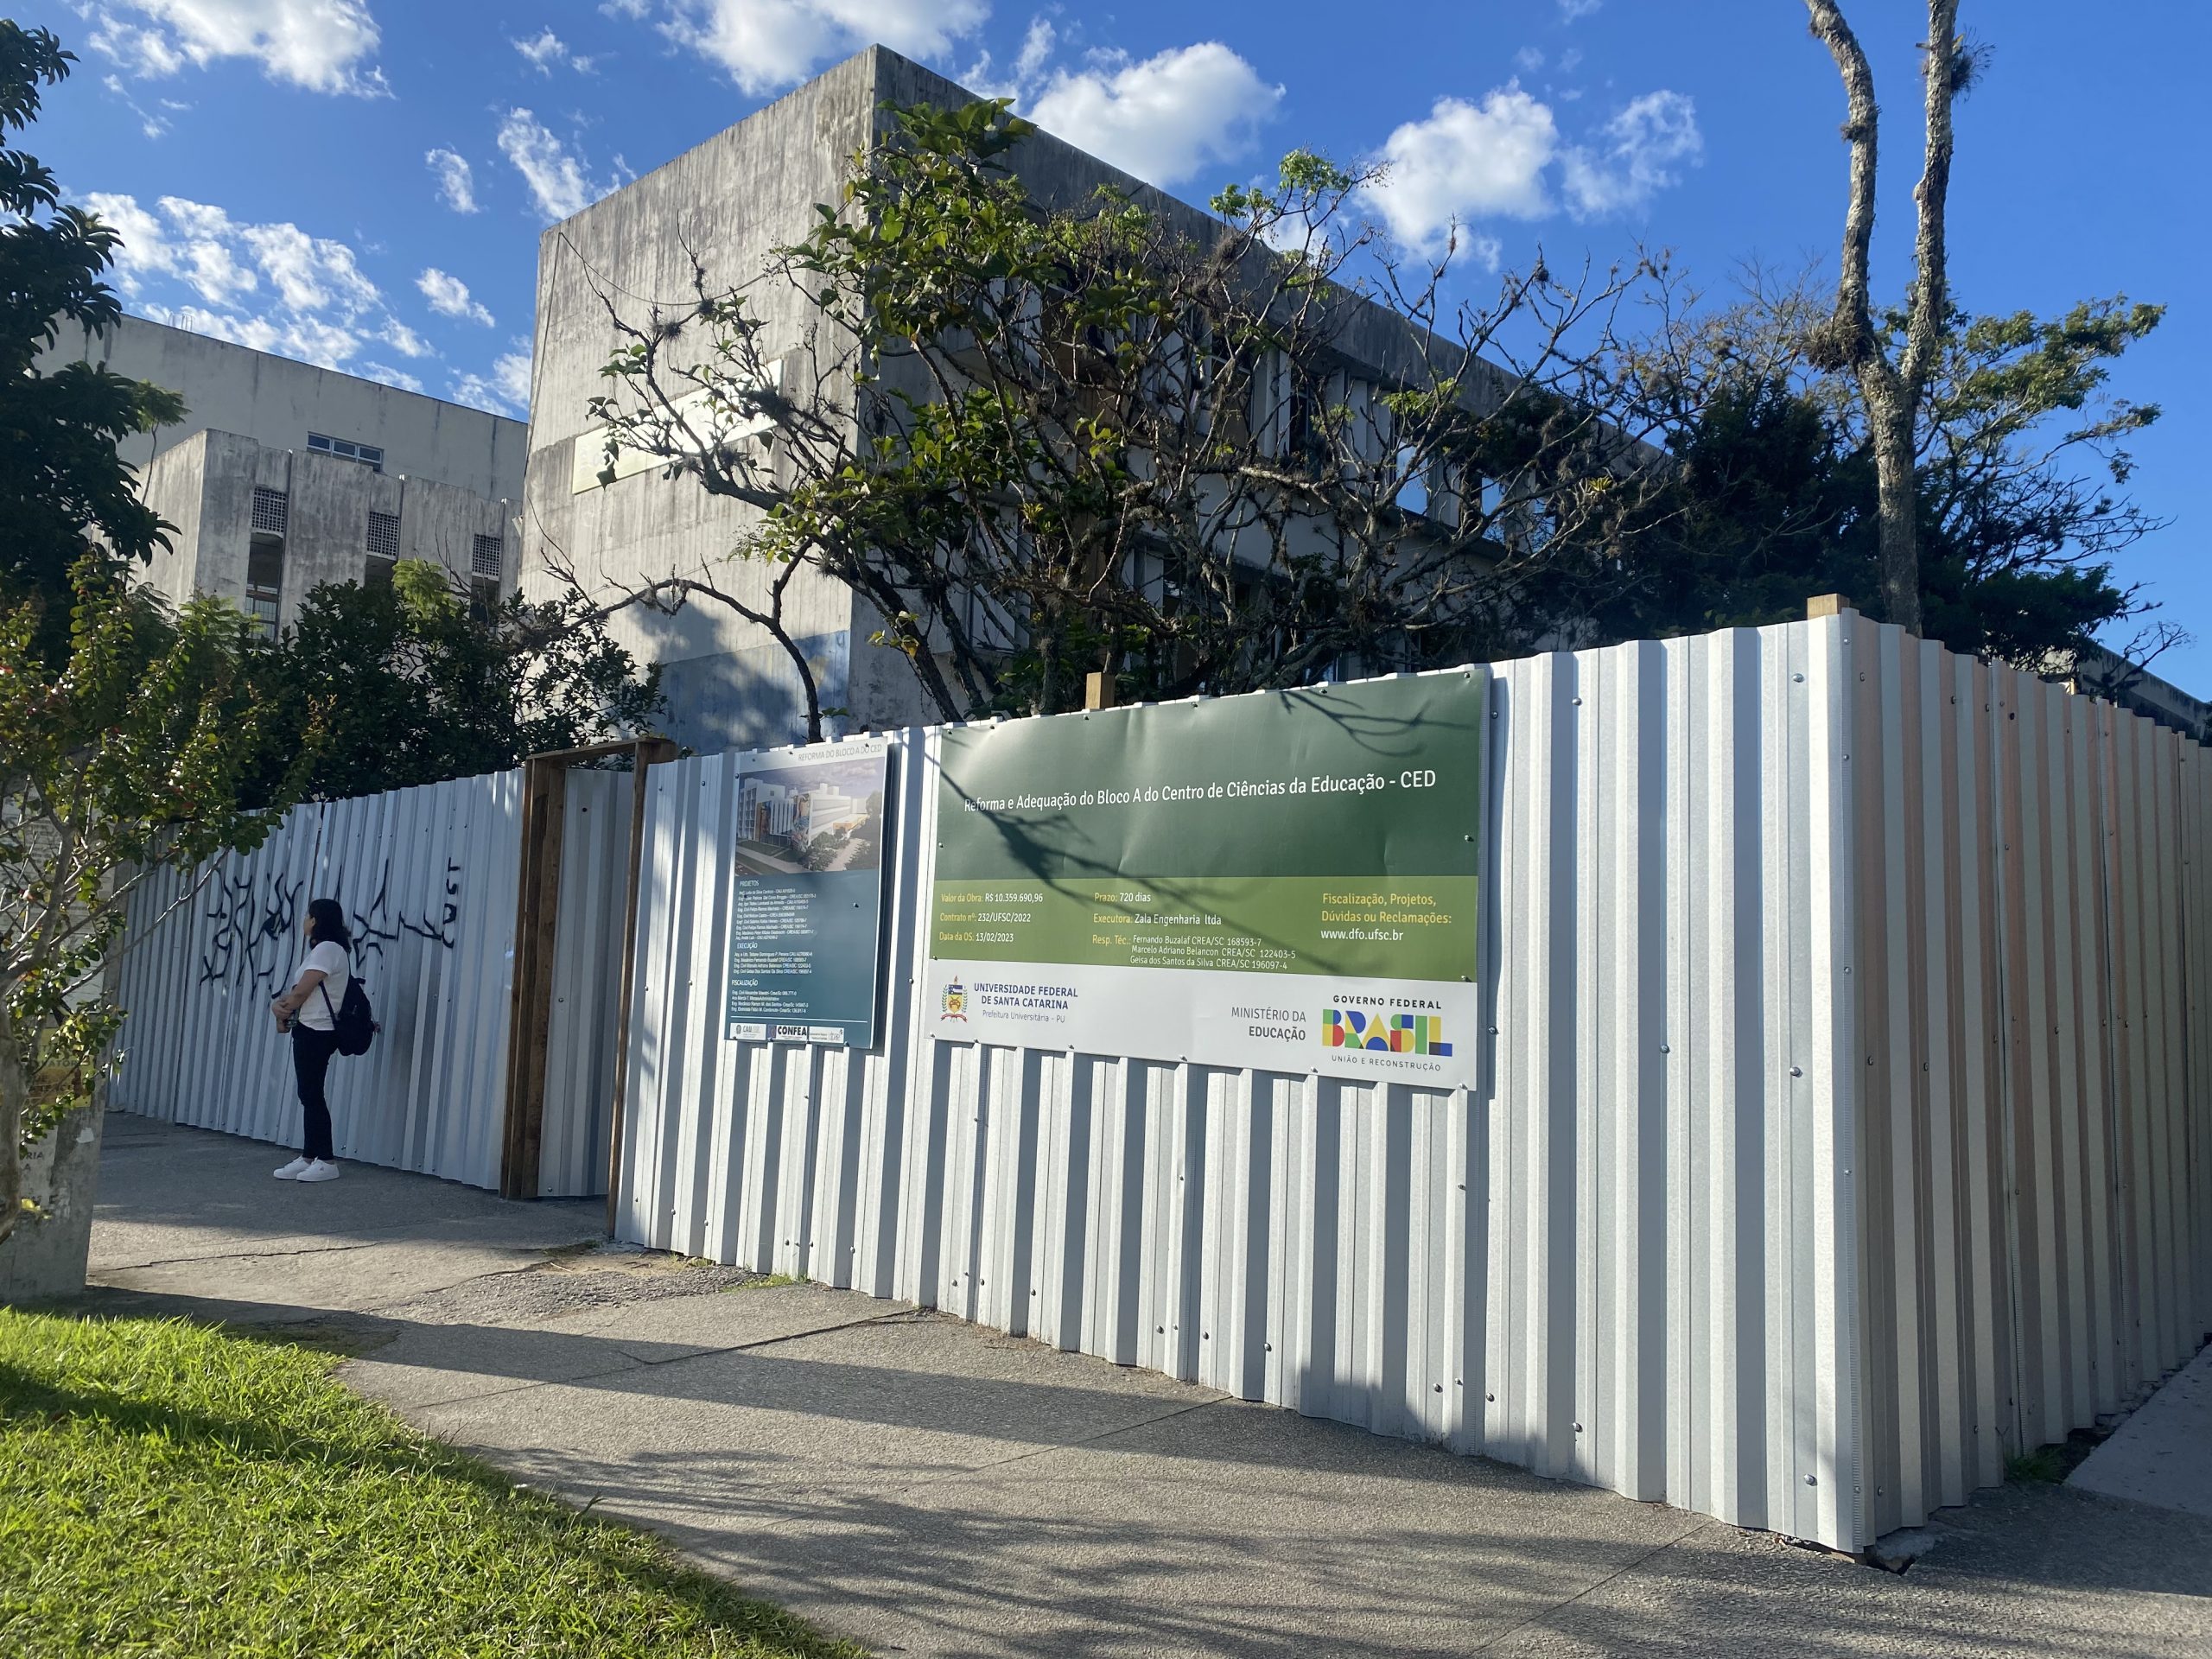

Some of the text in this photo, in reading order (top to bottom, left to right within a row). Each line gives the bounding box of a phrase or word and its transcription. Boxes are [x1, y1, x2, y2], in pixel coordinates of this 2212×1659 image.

[798, 751, 824, 760] REFORMA
[836, 747, 855, 757] BLOCO
[861, 746, 869, 754] DO
[870, 744, 881, 753] CED
[964, 798, 1005, 812] Reforma
[1007, 799, 1014, 810] e
[1016, 792, 1077, 811] Adequação
[1080, 792, 1094, 805] do
[1097, 790, 1129, 804] Bloco
[1133, 788, 1141, 803] A
[1144, 787, 1159, 802] do
[1162, 785, 1204, 801] Centro
[1207, 782, 1224, 798] de
[1227, 779, 1286, 798] Ciências
[1289, 777, 1306, 794] da
[1311, 773, 1384, 795] Educação
[1400, 769, 1436, 788] CED
[941, 893, 1043, 904] Valor da Obra: R$ 10.359.690,96
[1094, 891, 1152, 902] Prazo: 720 dias
[1322, 893, 1437, 907] Fiscalização, Projetos,
[939, 912, 966, 921] Contrato
[977, 912, 1031, 923] 232/UFSC/2022
[1093, 913, 1222, 926] Executora: Zala Engenharia ltda
[1321, 910, 1452, 925] Dúvidas ou Reclamações:
[939, 931, 1014, 943] Data da OS: 13/02/2023
[1092, 934, 1112, 947] Resp.
[1133, 934, 1163, 944] Fernando
[1165, 935, 1191, 945] Buzalaf
[1192, 936, 1224, 946] CREA/SC
[1227, 938, 1262, 947] 168593-7
[1320, 927, 1404, 941] www.dfo.ufsc.br
[1131, 944, 1296, 959] Marcelo Adriano Belancon CREA/SC 122403-5
[1130, 955, 1287, 970] Geisa dos Santos da Silva CREA/SC 196097-4
[974, 982, 1078, 998] UNIVERSIDADE FEDERAL
[981, 995, 1069, 1010] DE SANTA CATARINA
[1332, 995, 1442, 1010] GOVERNO FEDERAL
[982, 1009, 1009, 1020] Prefeitura
[1011, 1011, 1049, 1022] Universitária
[1056, 1014, 1065, 1023] PU
[1231, 1006, 1306, 1022] MINISTÉRIO DA
[777, 1026, 807, 1036] CONFEA
[1249, 1026, 1306, 1043] EDUCAÇÃO
[1322, 1008, 1452, 1057] BRASIL
[1332, 1054, 1357, 1065] UNIÃO
[1369, 1058, 1441, 1071] RECONSTRUÇÃO
